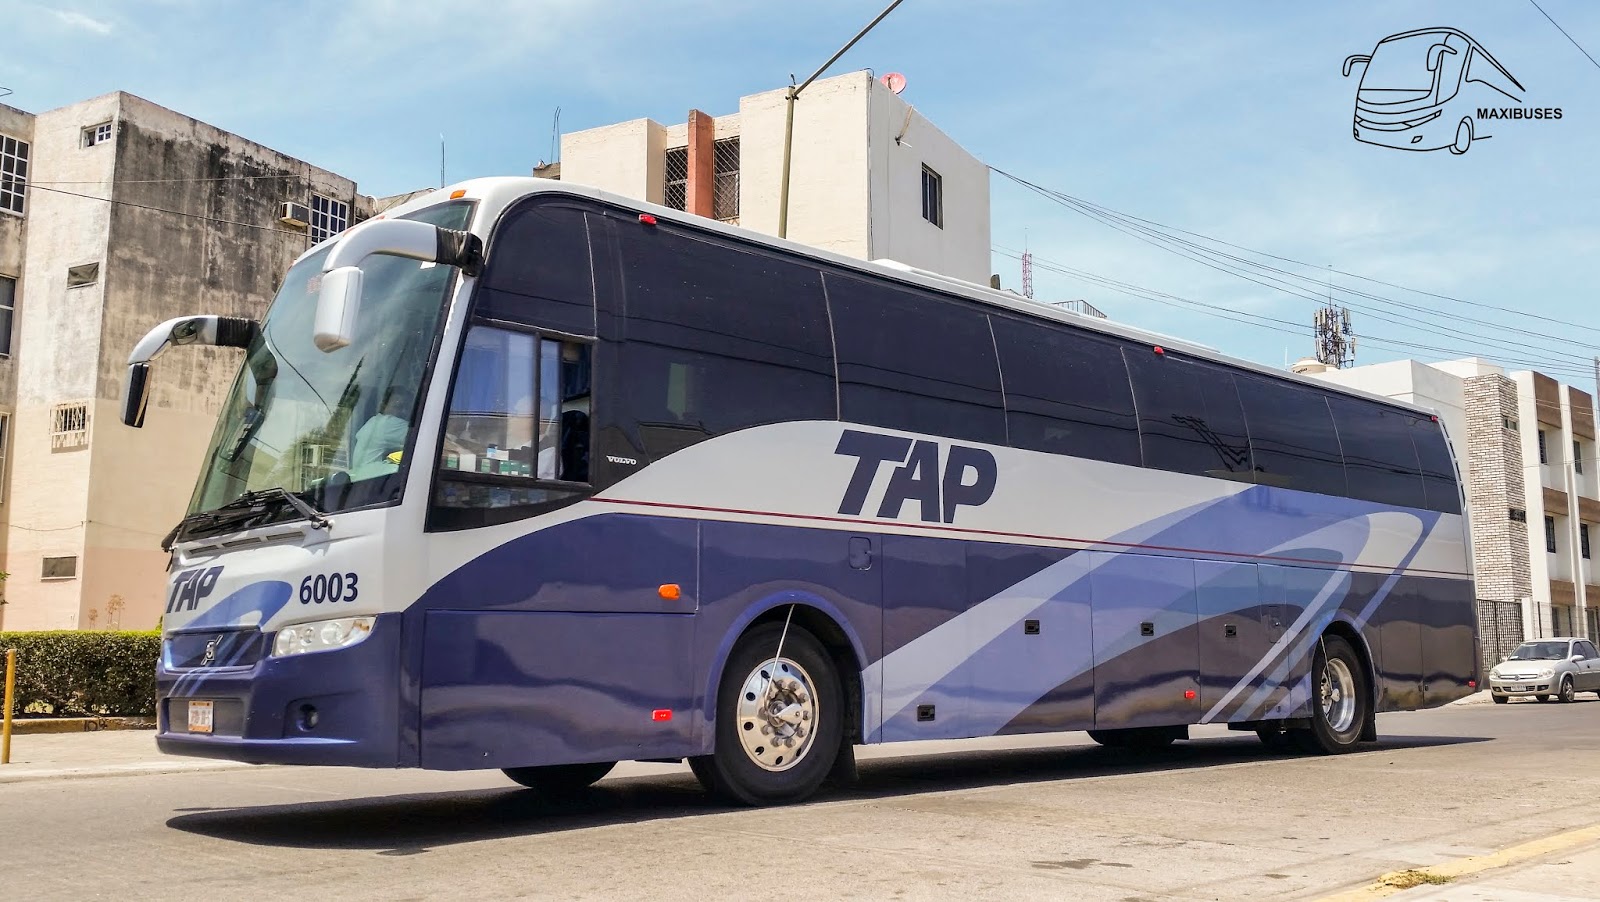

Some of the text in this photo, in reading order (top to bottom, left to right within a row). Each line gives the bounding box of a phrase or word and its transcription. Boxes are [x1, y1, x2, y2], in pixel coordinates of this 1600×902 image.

[606, 455, 637, 465] VOLVO
[835, 429, 997, 523] TAP
[166, 565, 224, 613] TAP
[299, 572, 358, 604] 6003
